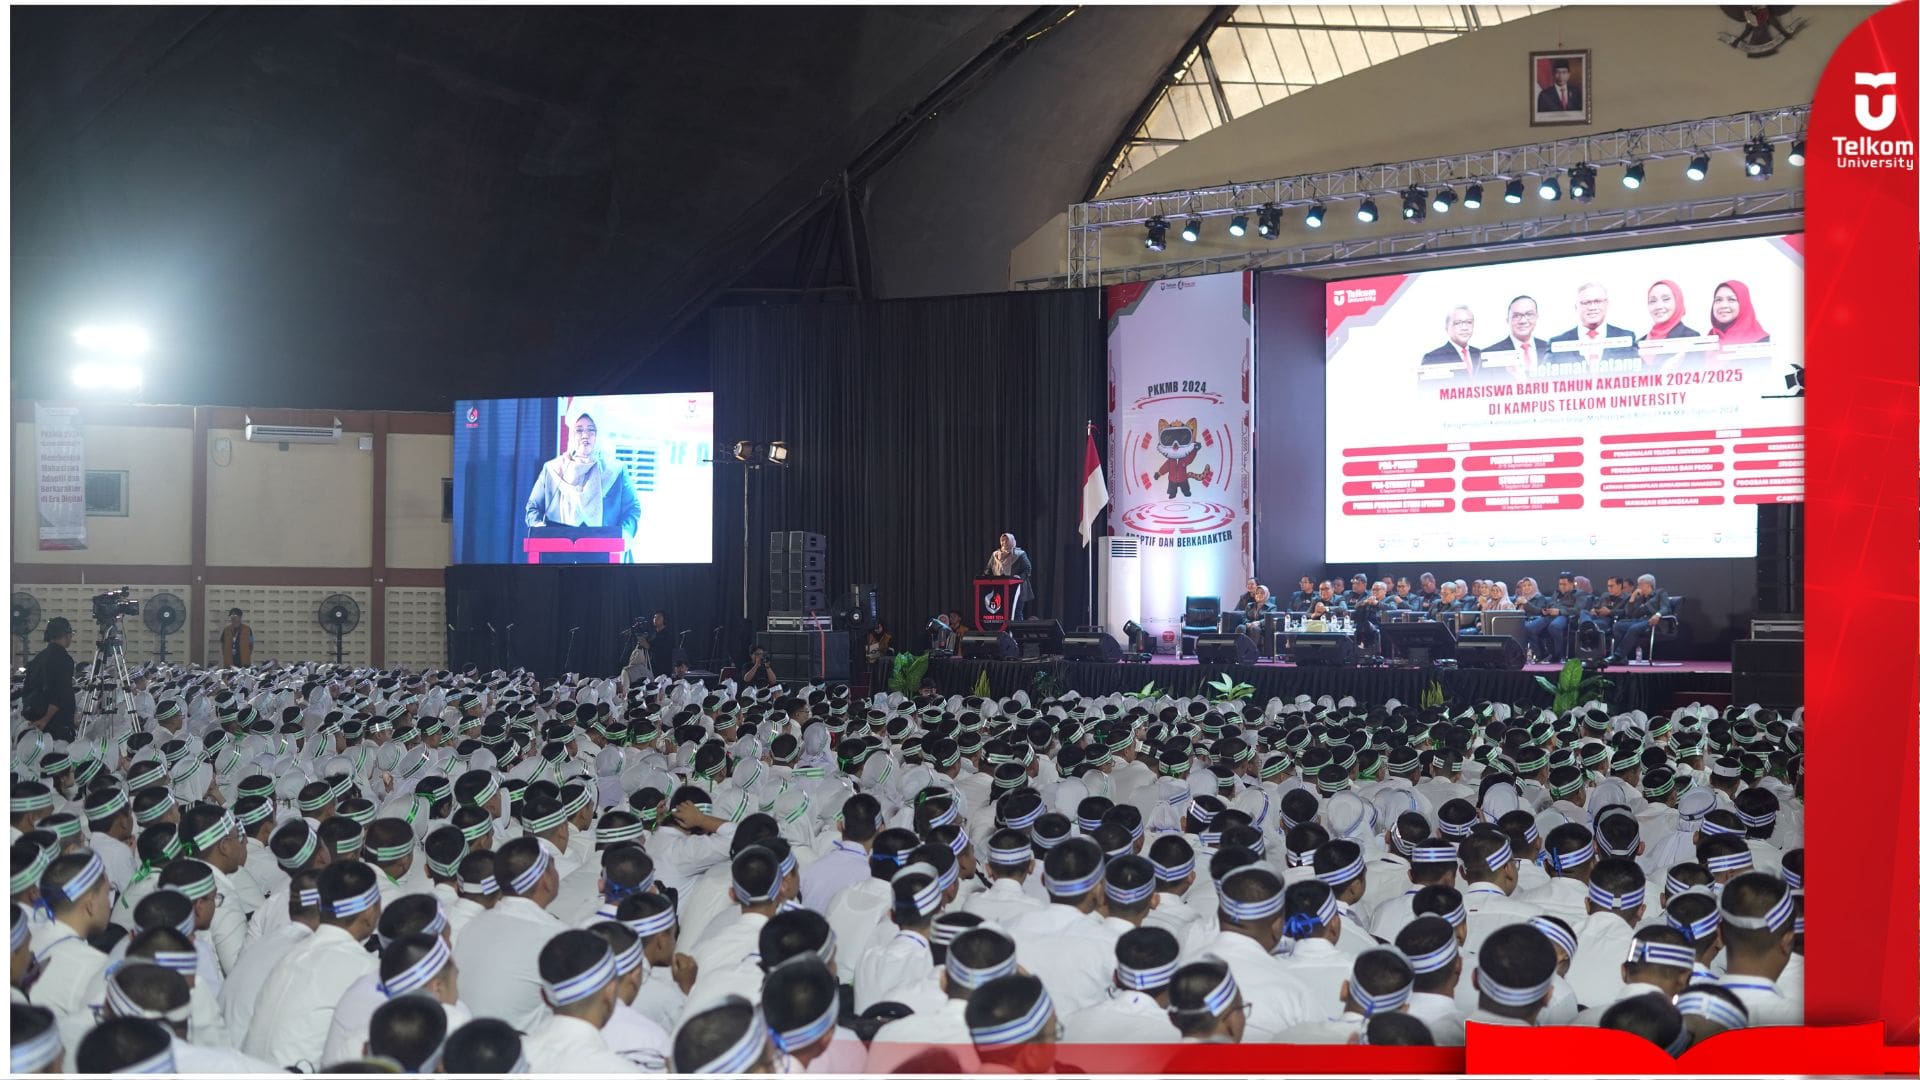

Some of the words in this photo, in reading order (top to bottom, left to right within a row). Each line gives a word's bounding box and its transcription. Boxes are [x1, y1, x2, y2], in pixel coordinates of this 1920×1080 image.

[1148, 381, 1178, 397] PKKMB
[1182, 380, 1206, 394] 2024
[1440, 384, 1513, 400] MAHASISWA
[1517, 381, 1549, 396] BARU
[1552, 378, 1592, 393] TAHUN
[1596, 374, 1662, 390] AKADEMIK
[1666, 368, 1743, 386] 2024/2025
[1488, 404, 1500, 415] DI
[1504, 400, 1556, 414] KAMPUS
[1559, 397, 1606, 411] TELKOM
[1610, 392, 1686, 408] UNIVERSITY
[1158, 537, 1174, 548] DAN
[1177, 530, 1232, 548] BERKARAKTER
